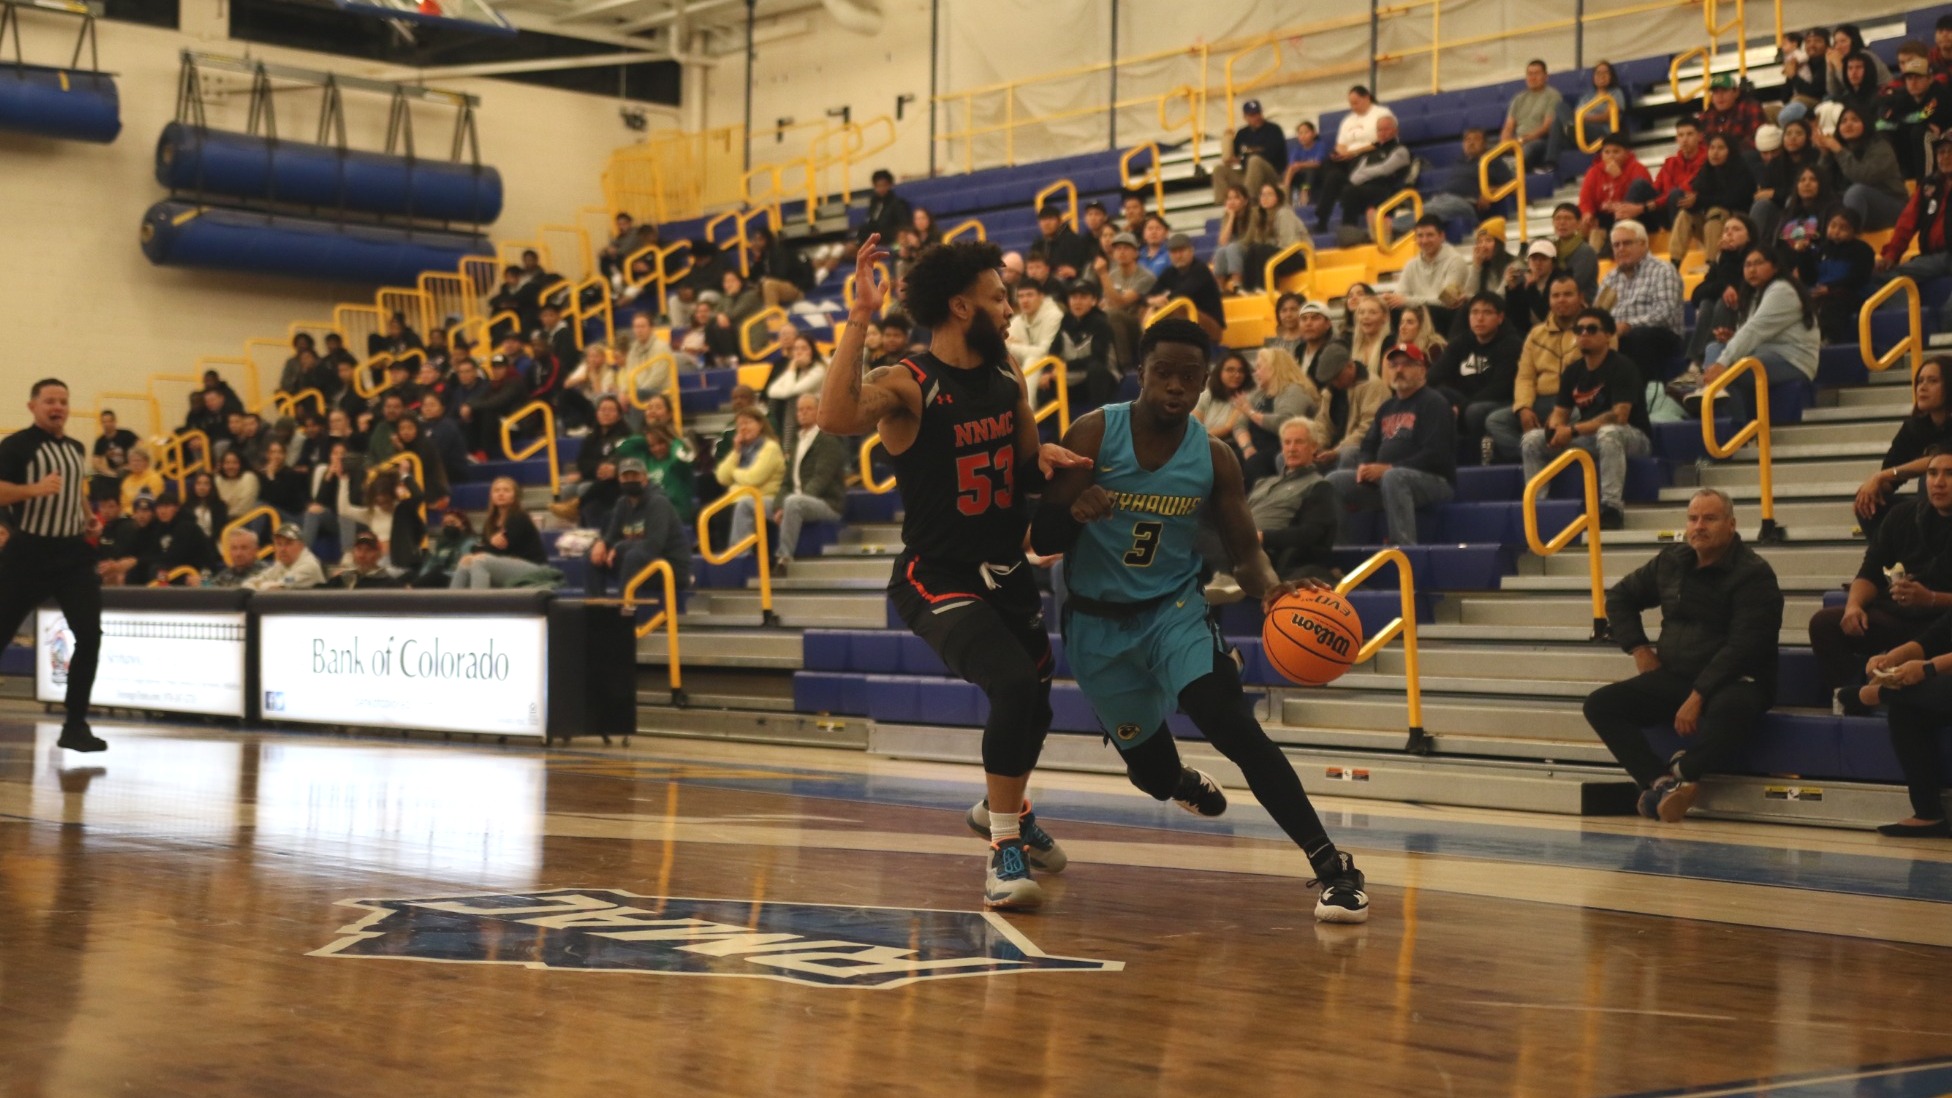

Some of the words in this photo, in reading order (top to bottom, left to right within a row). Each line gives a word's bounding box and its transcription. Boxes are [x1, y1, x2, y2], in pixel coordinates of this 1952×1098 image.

[954, 410, 1014, 448] NNMC
[956, 443, 1014, 516] 53
[1122, 521, 1164, 567] 3
[1315, 595, 1350, 616] EVO
[1292, 613, 1350, 656] Wilson
[313, 636, 365, 675] Bank
[372, 635, 395, 676] of
[399, 637, 510, 682] Colorado
[409, 894, 1035, 979] RMAC
